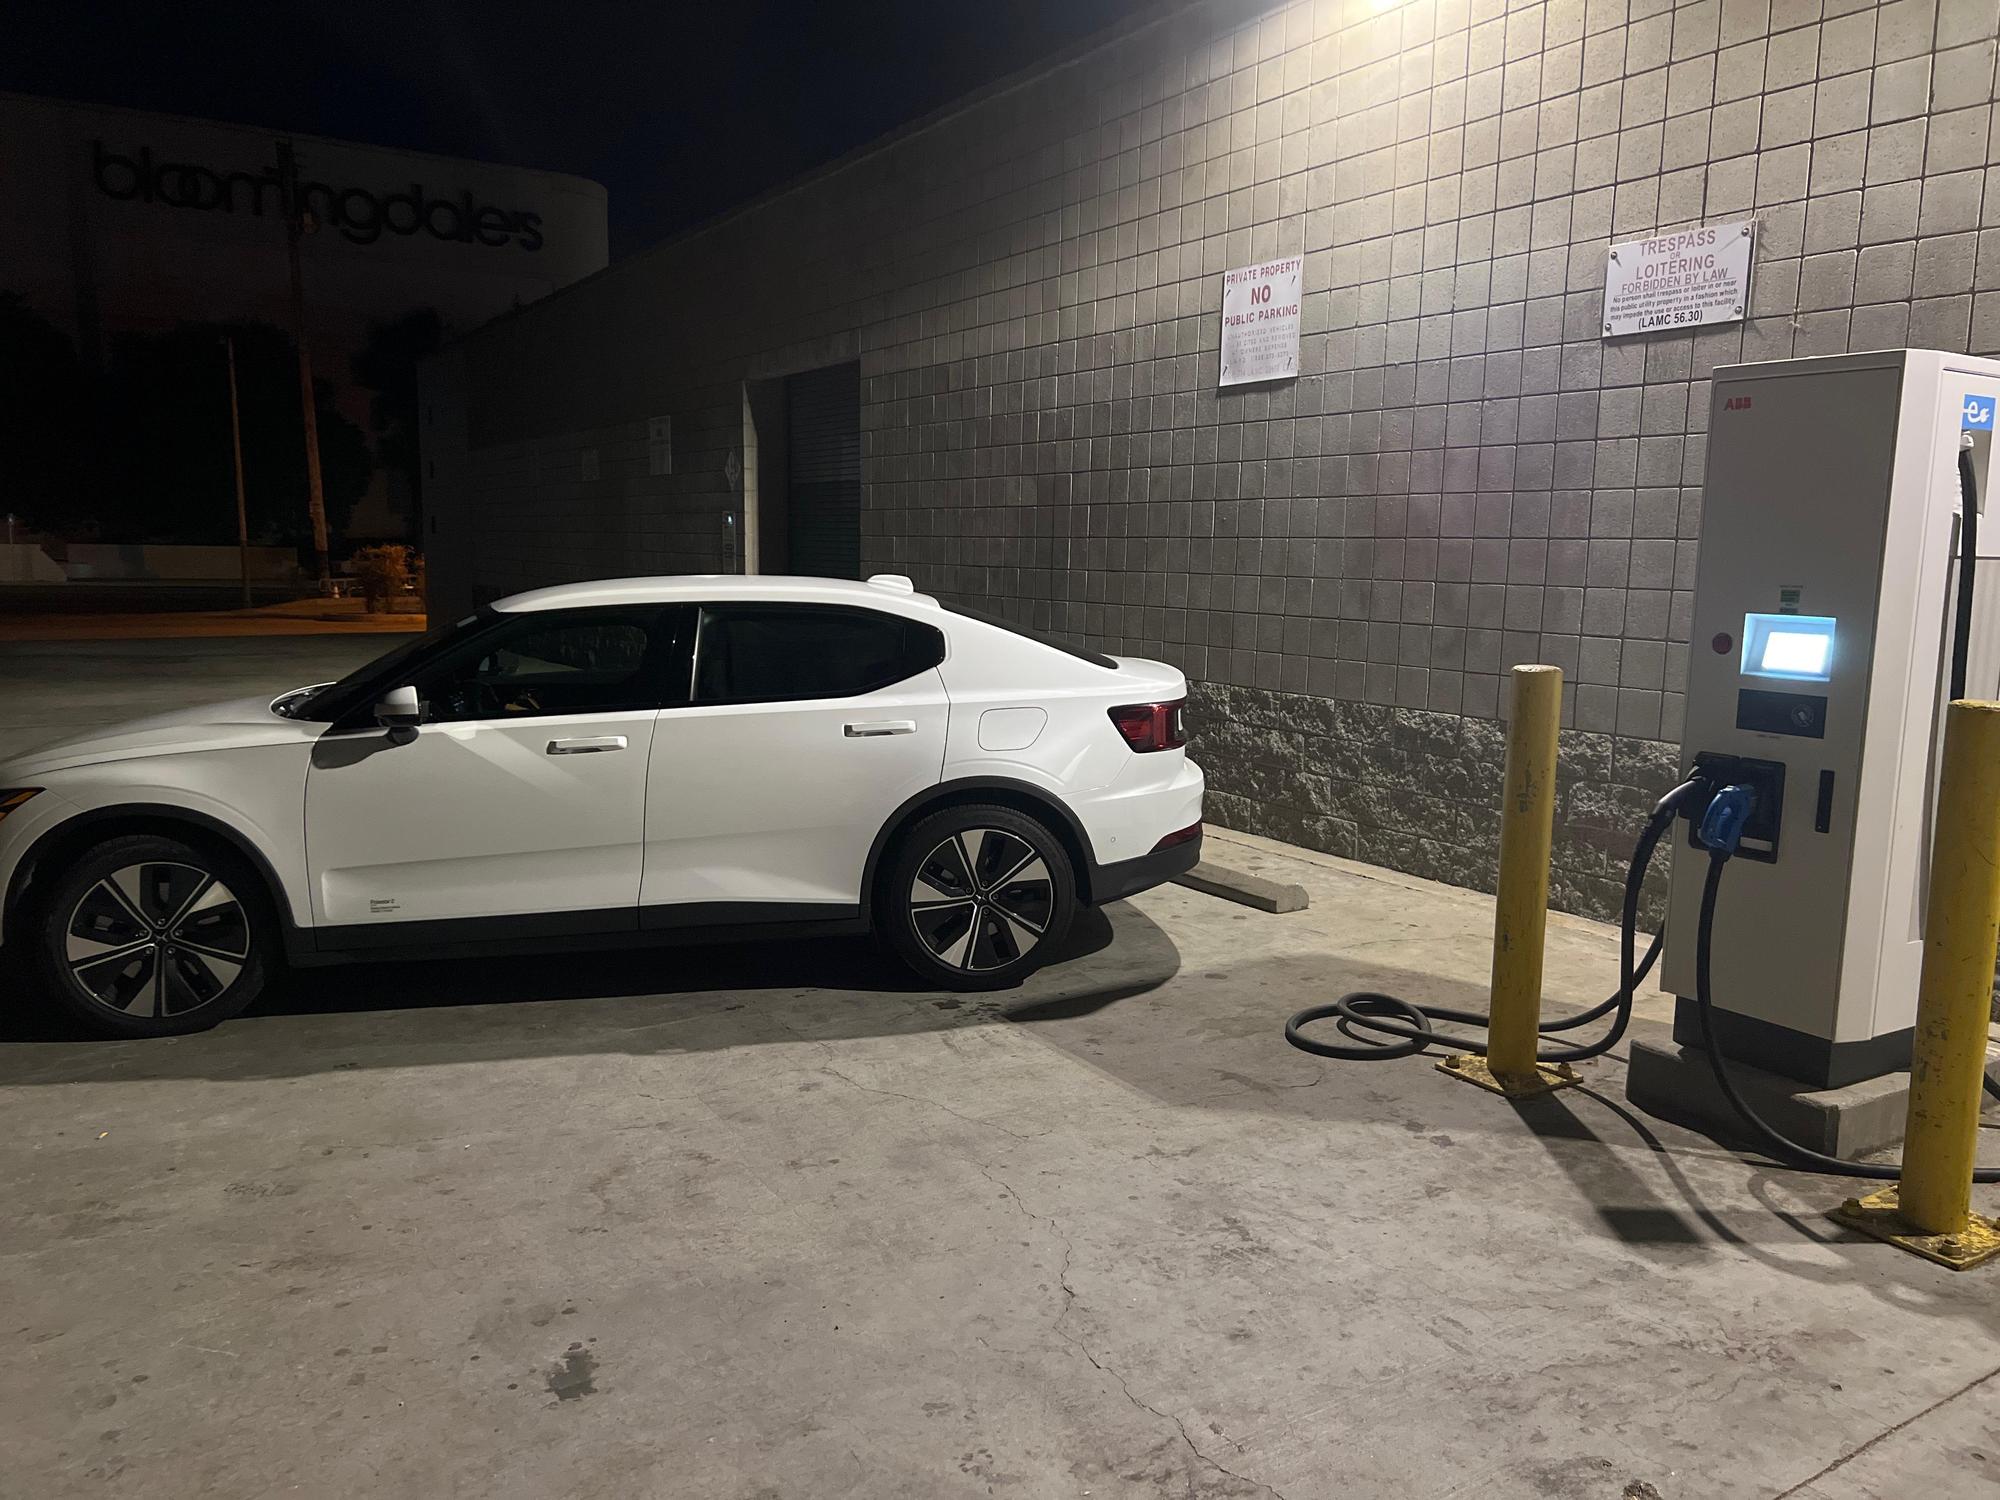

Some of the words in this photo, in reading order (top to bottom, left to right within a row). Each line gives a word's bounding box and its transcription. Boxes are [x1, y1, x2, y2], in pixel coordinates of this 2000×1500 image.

[1640, 230, 1716, 256] TRESPASS
[1670, 251, 1681, 259] OR
[1226, 269, 1257, 285] PRIVATE
[1260, 259, 1301, 278] PROPERTY
[1636, 254, 1715, 280] LOITERING
[1622, 276, 1681, 294] FORBIDDEN
[1685, 272, 1699, 285] BY
[1703, 268, 1728, 282] LAW
[1251, 285, 1271, 305] NO
[1621, 302, 1638, 312] public
[1639, 300, 1656, 310] utility
[1656, 297, 1682, 308] property
[1695, 291, 1718, 300] fashion
[1719, 288, 1738, 297] which
[1622, 293, 1641, 304] person
[1643, 291, 1656, 299] shall
[1657, 288, 1682, 298] trespass
[1225, 312, 1255, 327] PUBLIC
[1259, 304, 1298, 320] PARKING
[1623, 310, 1643, 320] impede
[1644, 308, 1653, 316] the
[1673, 304, 1693, 312] access
[1702, 300, 1713, 308] this
[1714, 297, 1736, 307] facility
[1638, 314, 1671, 330] (LAMC
[1674, 310, 1703, 323] 56.30)
[1723, 397, 1752, 411] ABB
